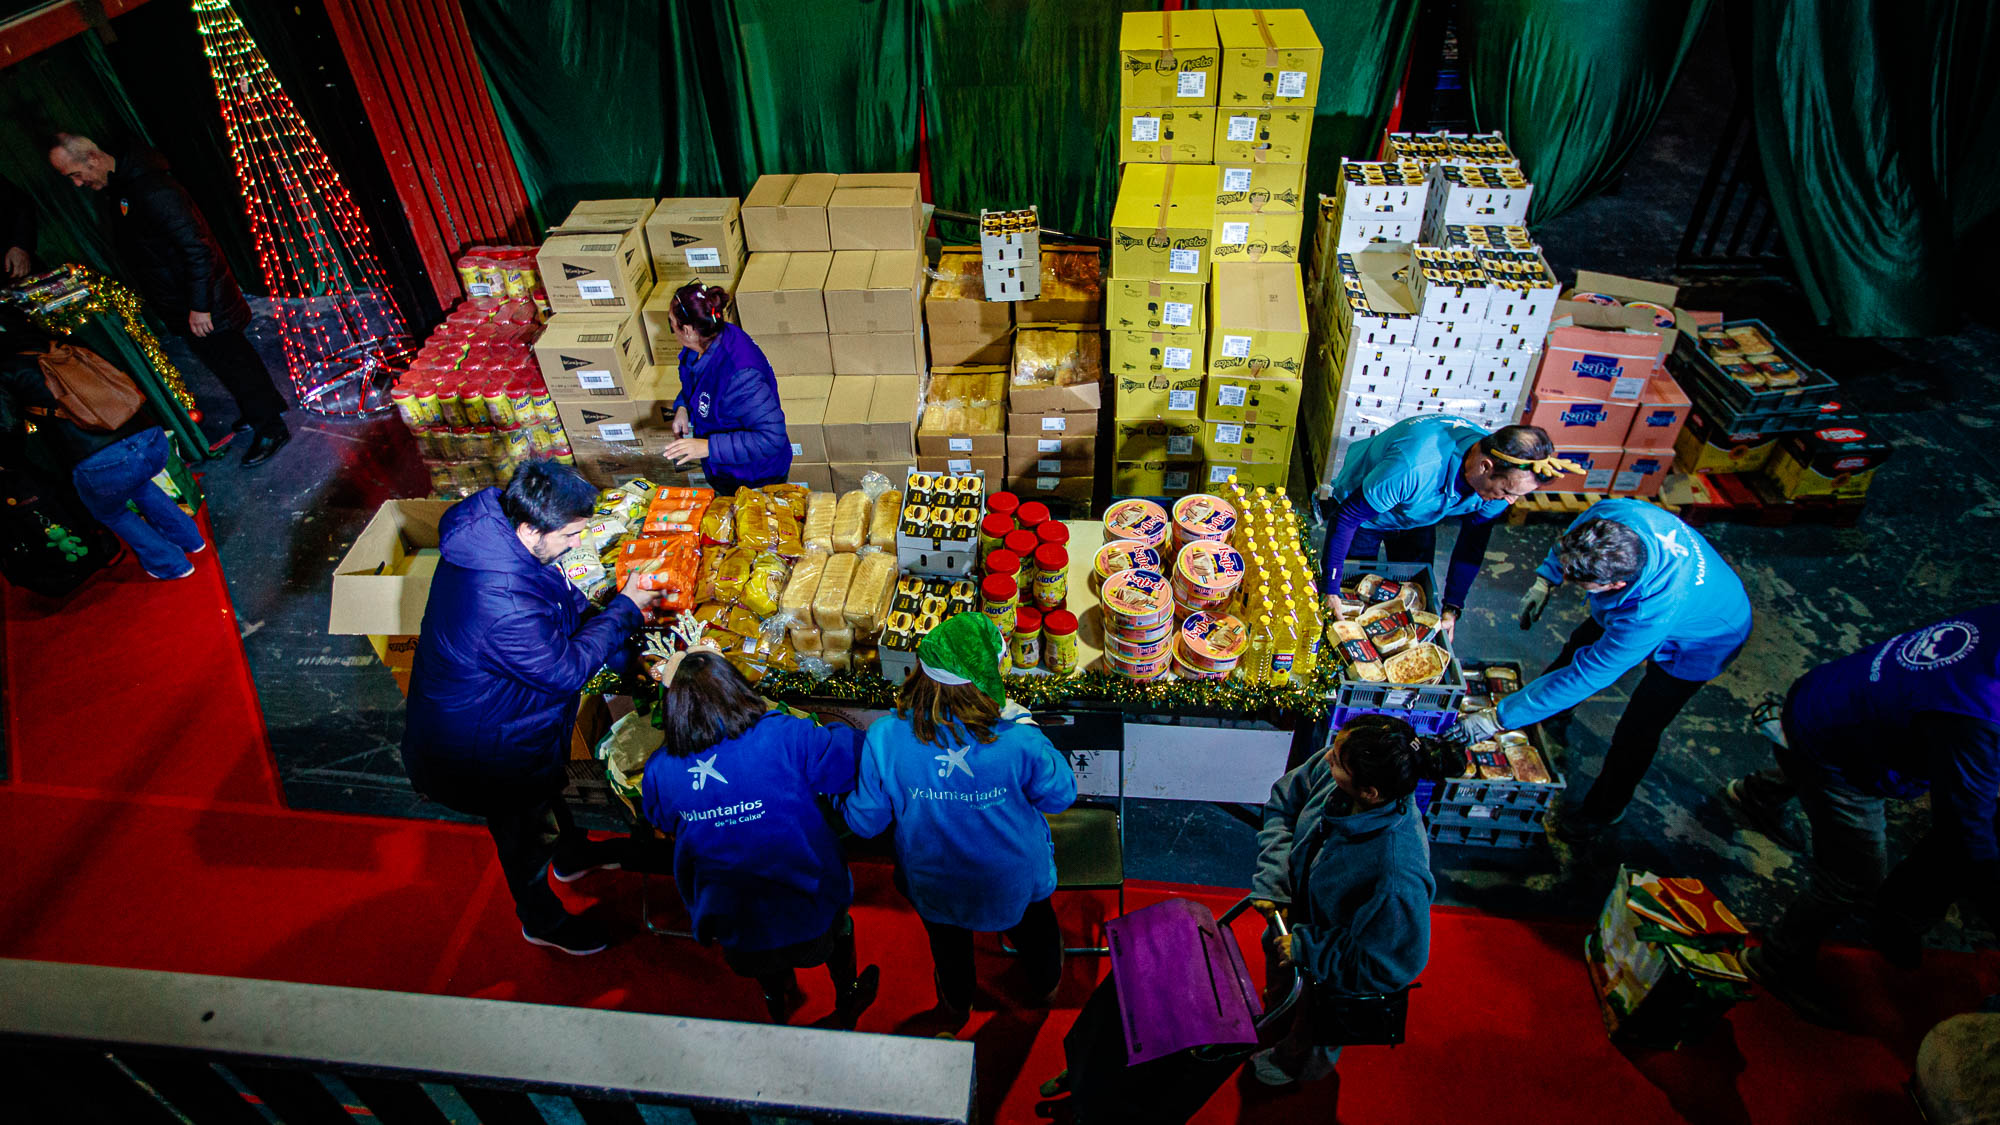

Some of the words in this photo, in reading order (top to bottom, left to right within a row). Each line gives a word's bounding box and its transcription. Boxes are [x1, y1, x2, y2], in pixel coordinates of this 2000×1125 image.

[1571, 360, 1624, 378] Isabel
[1560, 410, 1608, 424] Isabel
[1132, 514, 1165, 537] Isabel
[1206, 510, 1234, 532] Isabel
[1133, 545, 1154, 571] Isabel
[1218, 547, 1238, 578] Isabel
[1122, 571, 1167, 592] Isabel
[1185, 613, 1217, 641] Isabel
[908, 786, 1008, 802] Voluntariado
[679, 799, 763, 822] Voluntarios
